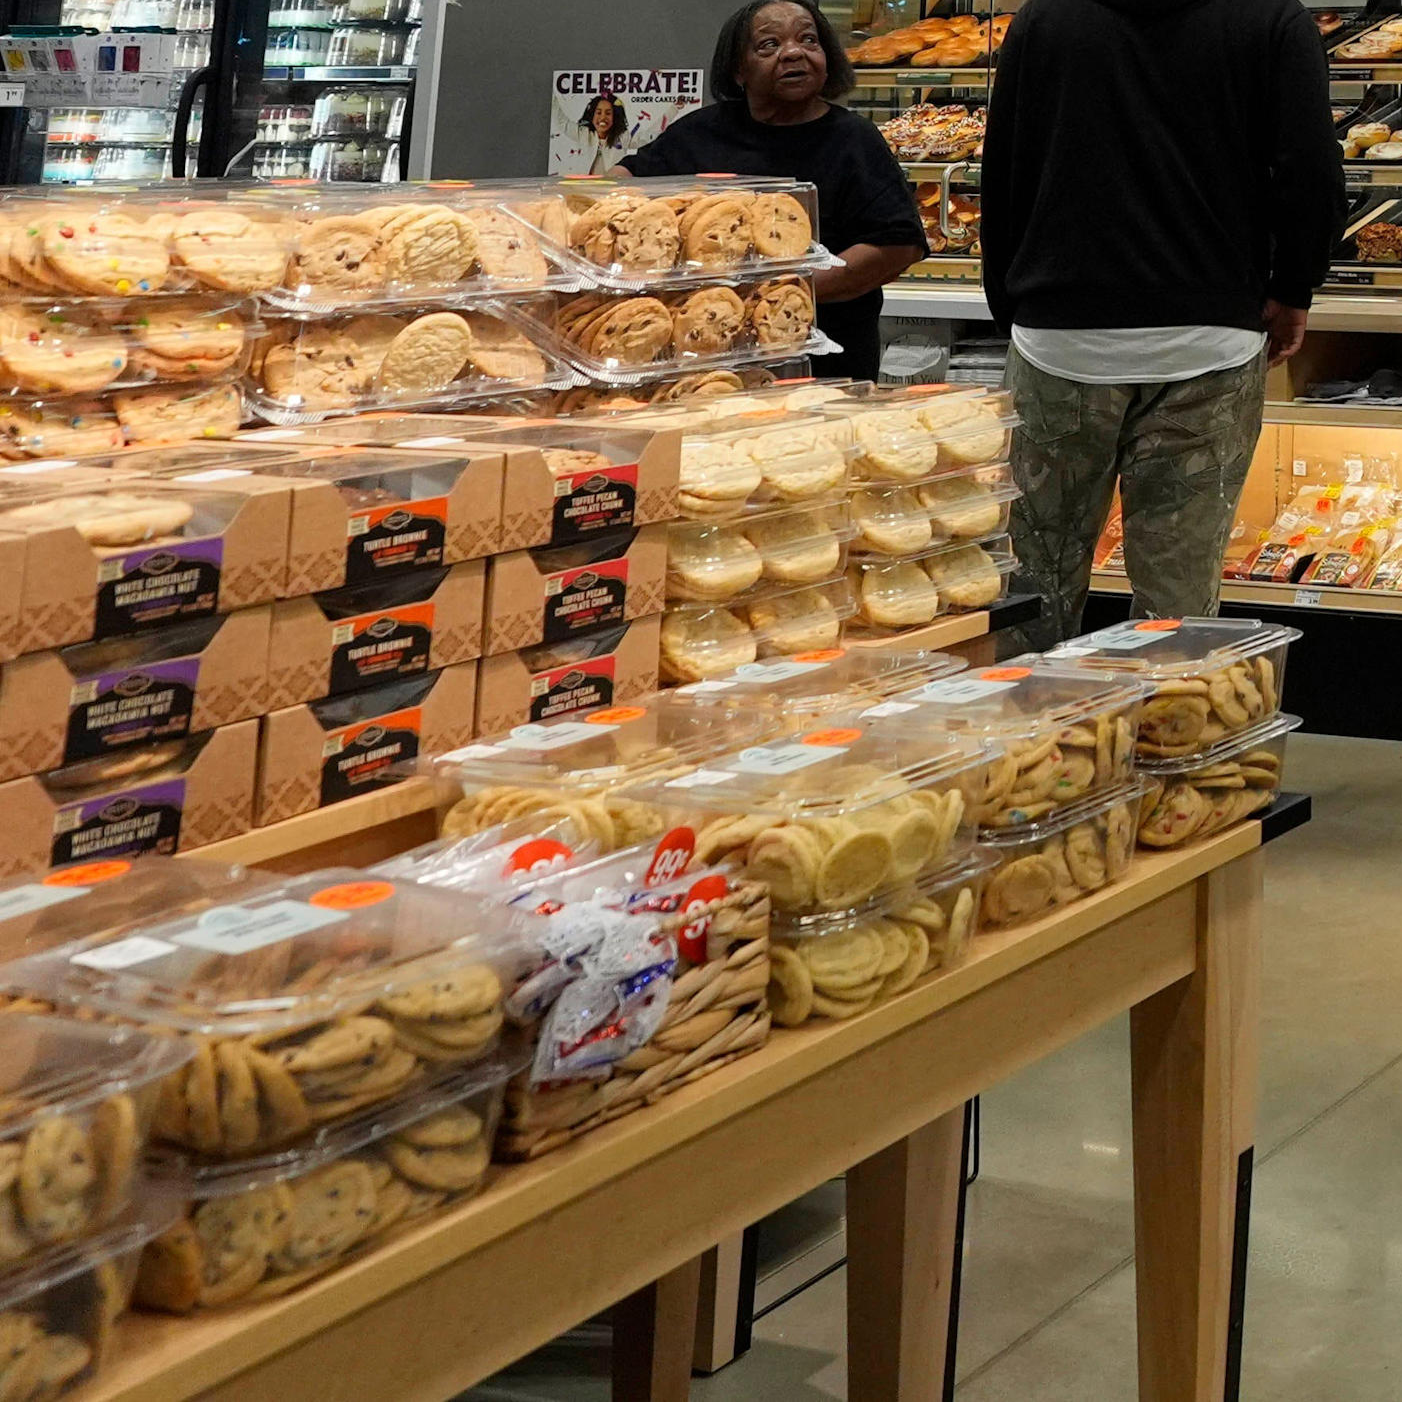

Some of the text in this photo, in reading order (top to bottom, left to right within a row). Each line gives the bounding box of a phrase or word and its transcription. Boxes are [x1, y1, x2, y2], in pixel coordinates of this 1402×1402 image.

[556, 71, 699, 95] CELEBRATE!
[630, 95, 677, 104] ORDER CAKES
[571, 491, 618, 507] TOFFEE PECAN
[563, 503, 599, 518] CHOCOLATE
[363, 529, 428, 552] TURTLE BROWNIE
[561, 587, 608, 605] TOFFEE PECAN
[554, 600, 590, 617] CHOCOLATE
[348, 645, 375, 662] TURTLE
[548, 684, 596, 705] TOFFEE PECAN
[540, 700, 577, 718] CHOCOLATE
